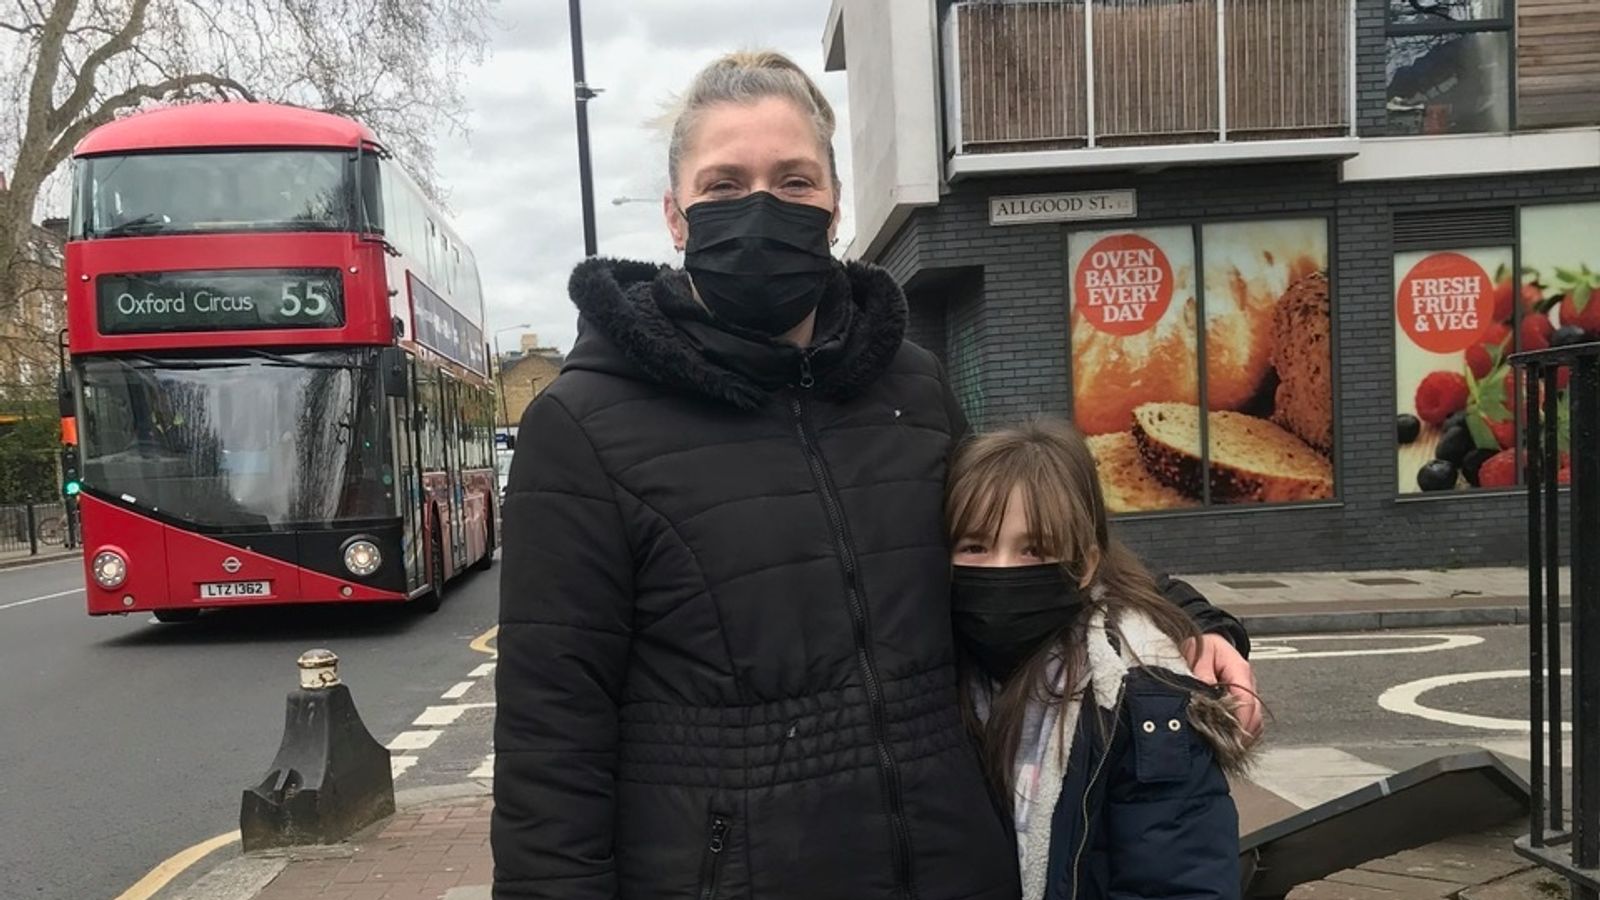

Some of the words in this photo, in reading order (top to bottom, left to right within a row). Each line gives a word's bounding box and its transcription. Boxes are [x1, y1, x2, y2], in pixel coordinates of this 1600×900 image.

[996, 199, 1083, 216] ALLGOOD
[1088, 195, 1113, 211] ST.
[1091, 249, 1155, 270] OVEN
[1084, 266, 1163, 288] BAKED
[1410, 276, 1481, 297] FRESH
[117, 291, 185, 315] Oxford
[194, 290, 254, 312] Circus
[279, 280, 327, 317] 55
[1087, 284, 1161, 306] EVERY
[1412, 294, 1480, 315] FRUIT
[1102, 303, 1147, 323] DAY
[1414, 314, 1430, 333] &
[1432, 311, 1479, 331] VEG
